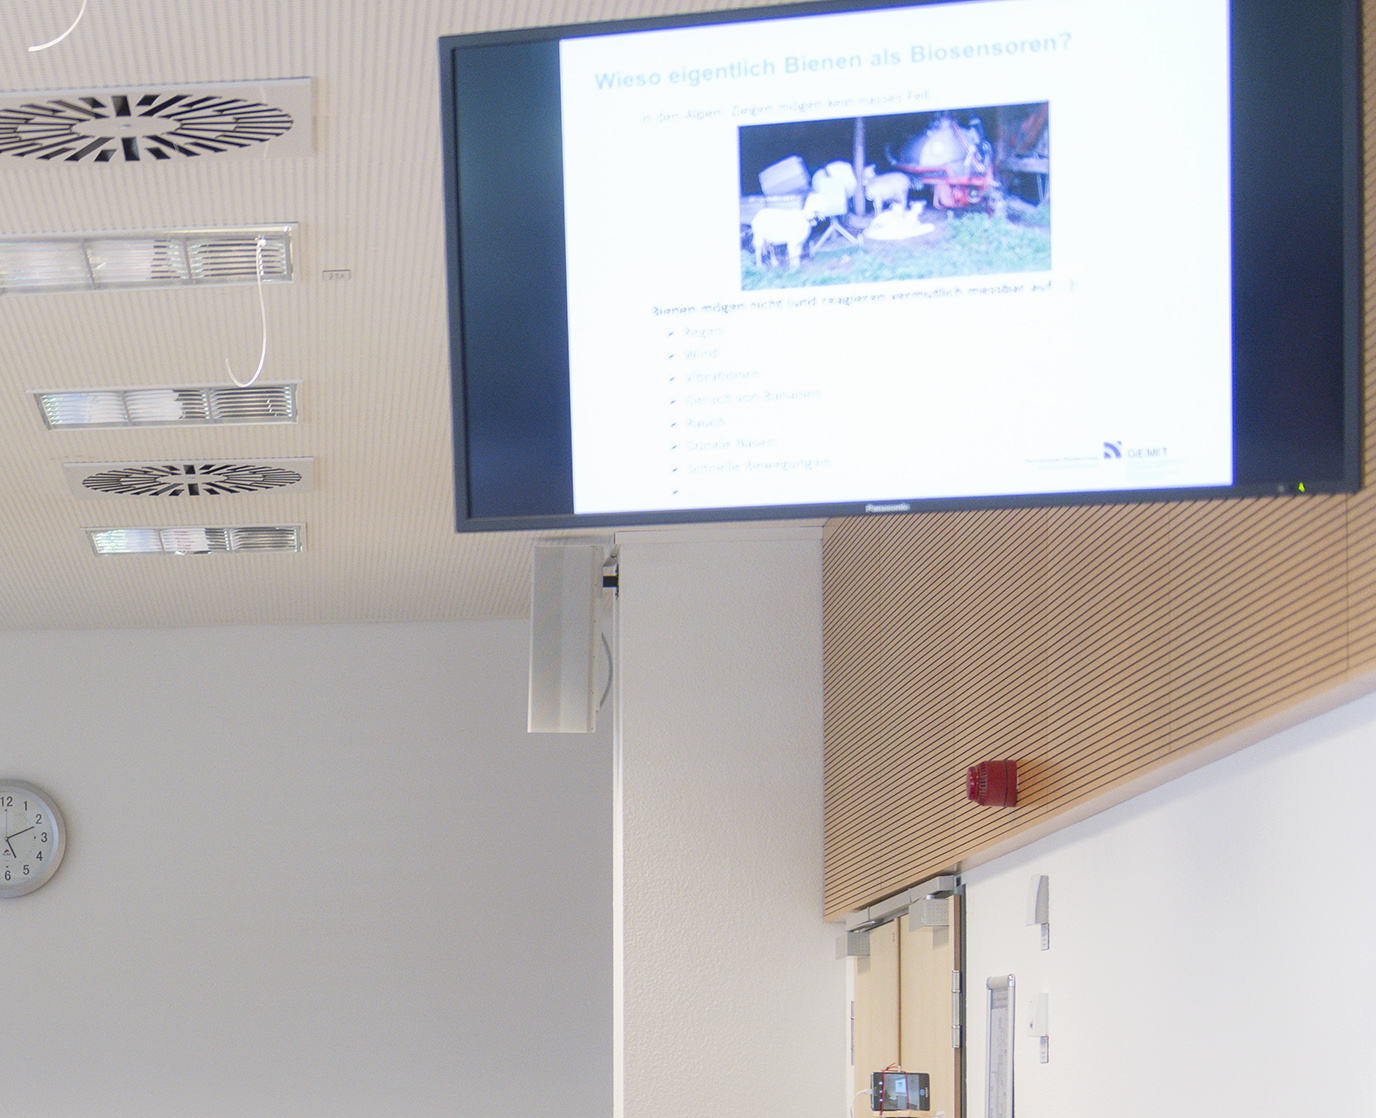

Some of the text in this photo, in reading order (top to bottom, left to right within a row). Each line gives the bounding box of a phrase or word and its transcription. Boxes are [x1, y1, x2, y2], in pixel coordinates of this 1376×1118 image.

[593, 31, 1072, 91] Wieso eigentlich Bienen als Biosensoren?
[865, 503, 910, 513] Panasonic
[0, 796, 13, 807] 12
[23, 801, 28, 811] 1
[35, 814, 42, 824] 2
[41, 832, 47, 842] 3
[36, 851, 43, 861] 4
[23, 865, 30, 875] 5
[4, 870, 11, 881] 6
